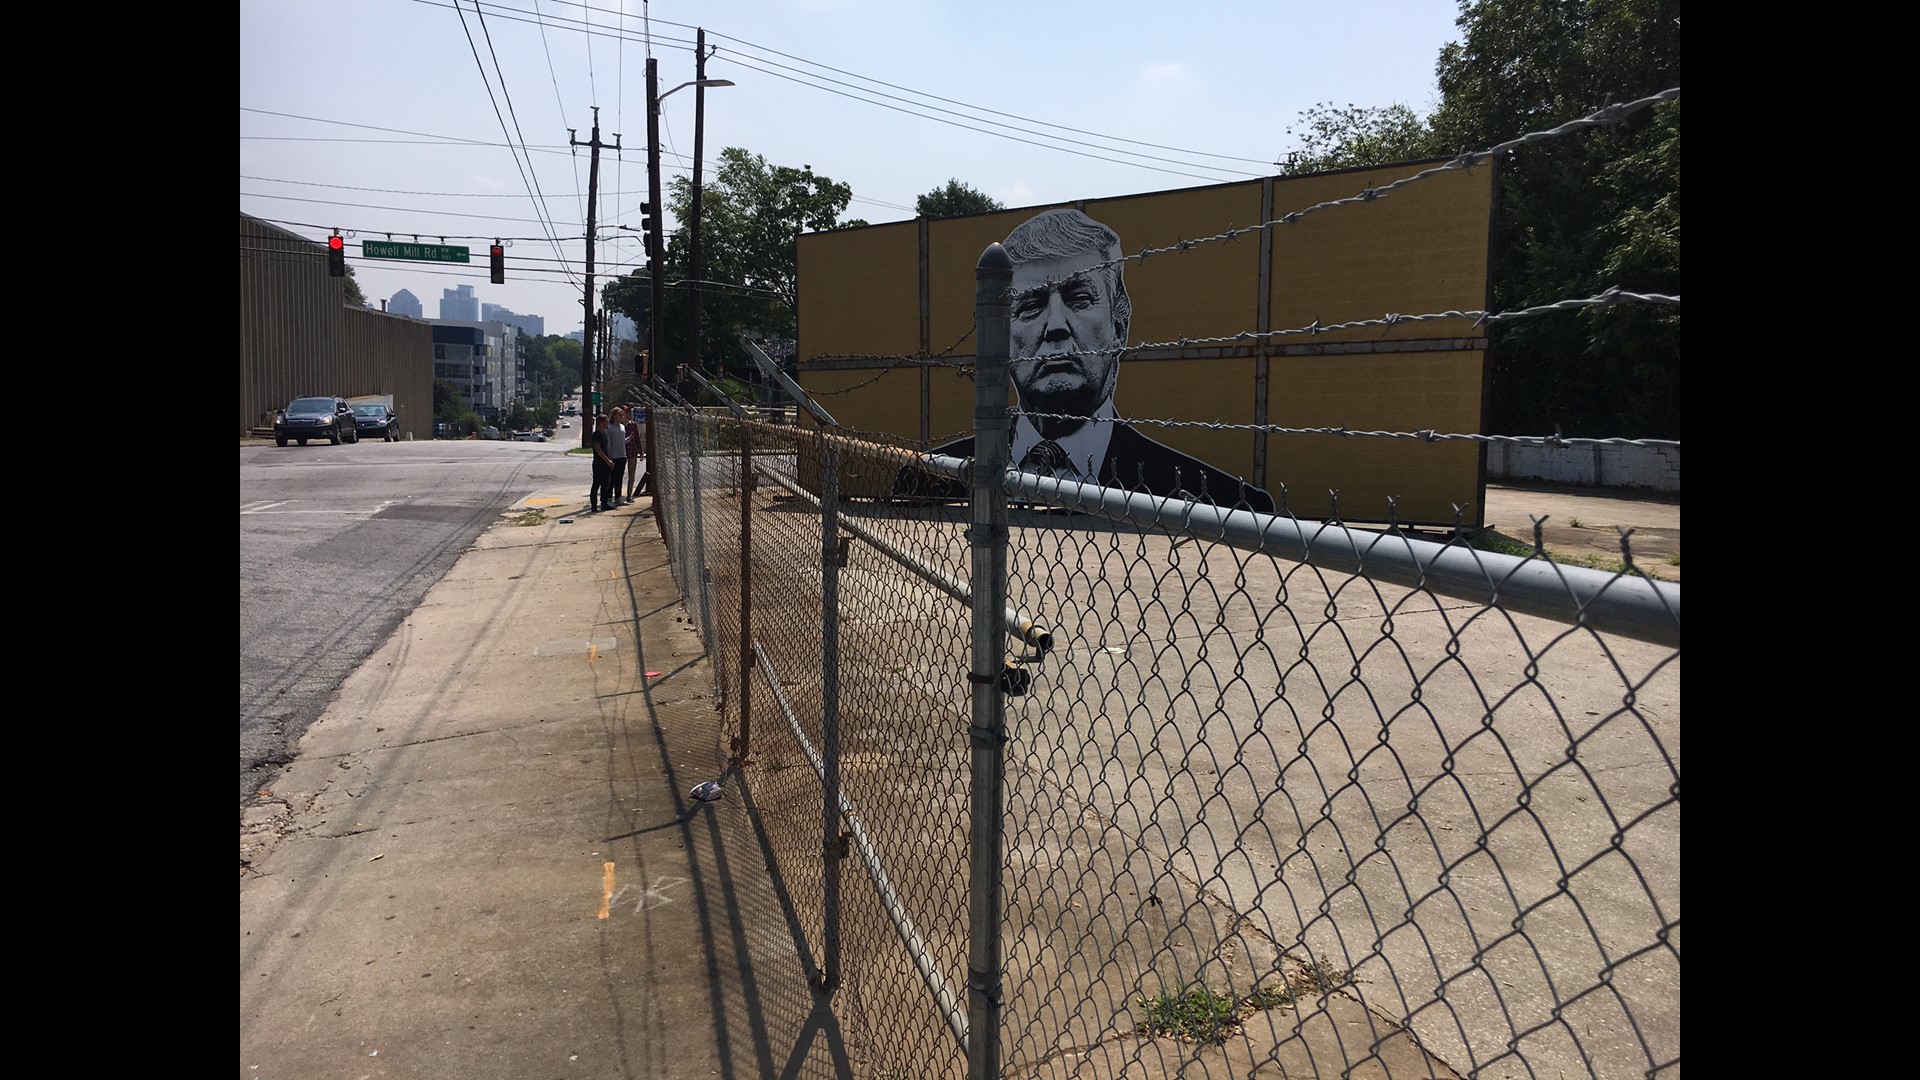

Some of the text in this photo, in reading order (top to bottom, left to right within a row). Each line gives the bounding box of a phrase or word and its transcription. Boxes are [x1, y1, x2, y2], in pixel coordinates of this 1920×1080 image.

[366, 243, 437, 259] Howell Mill Rd
